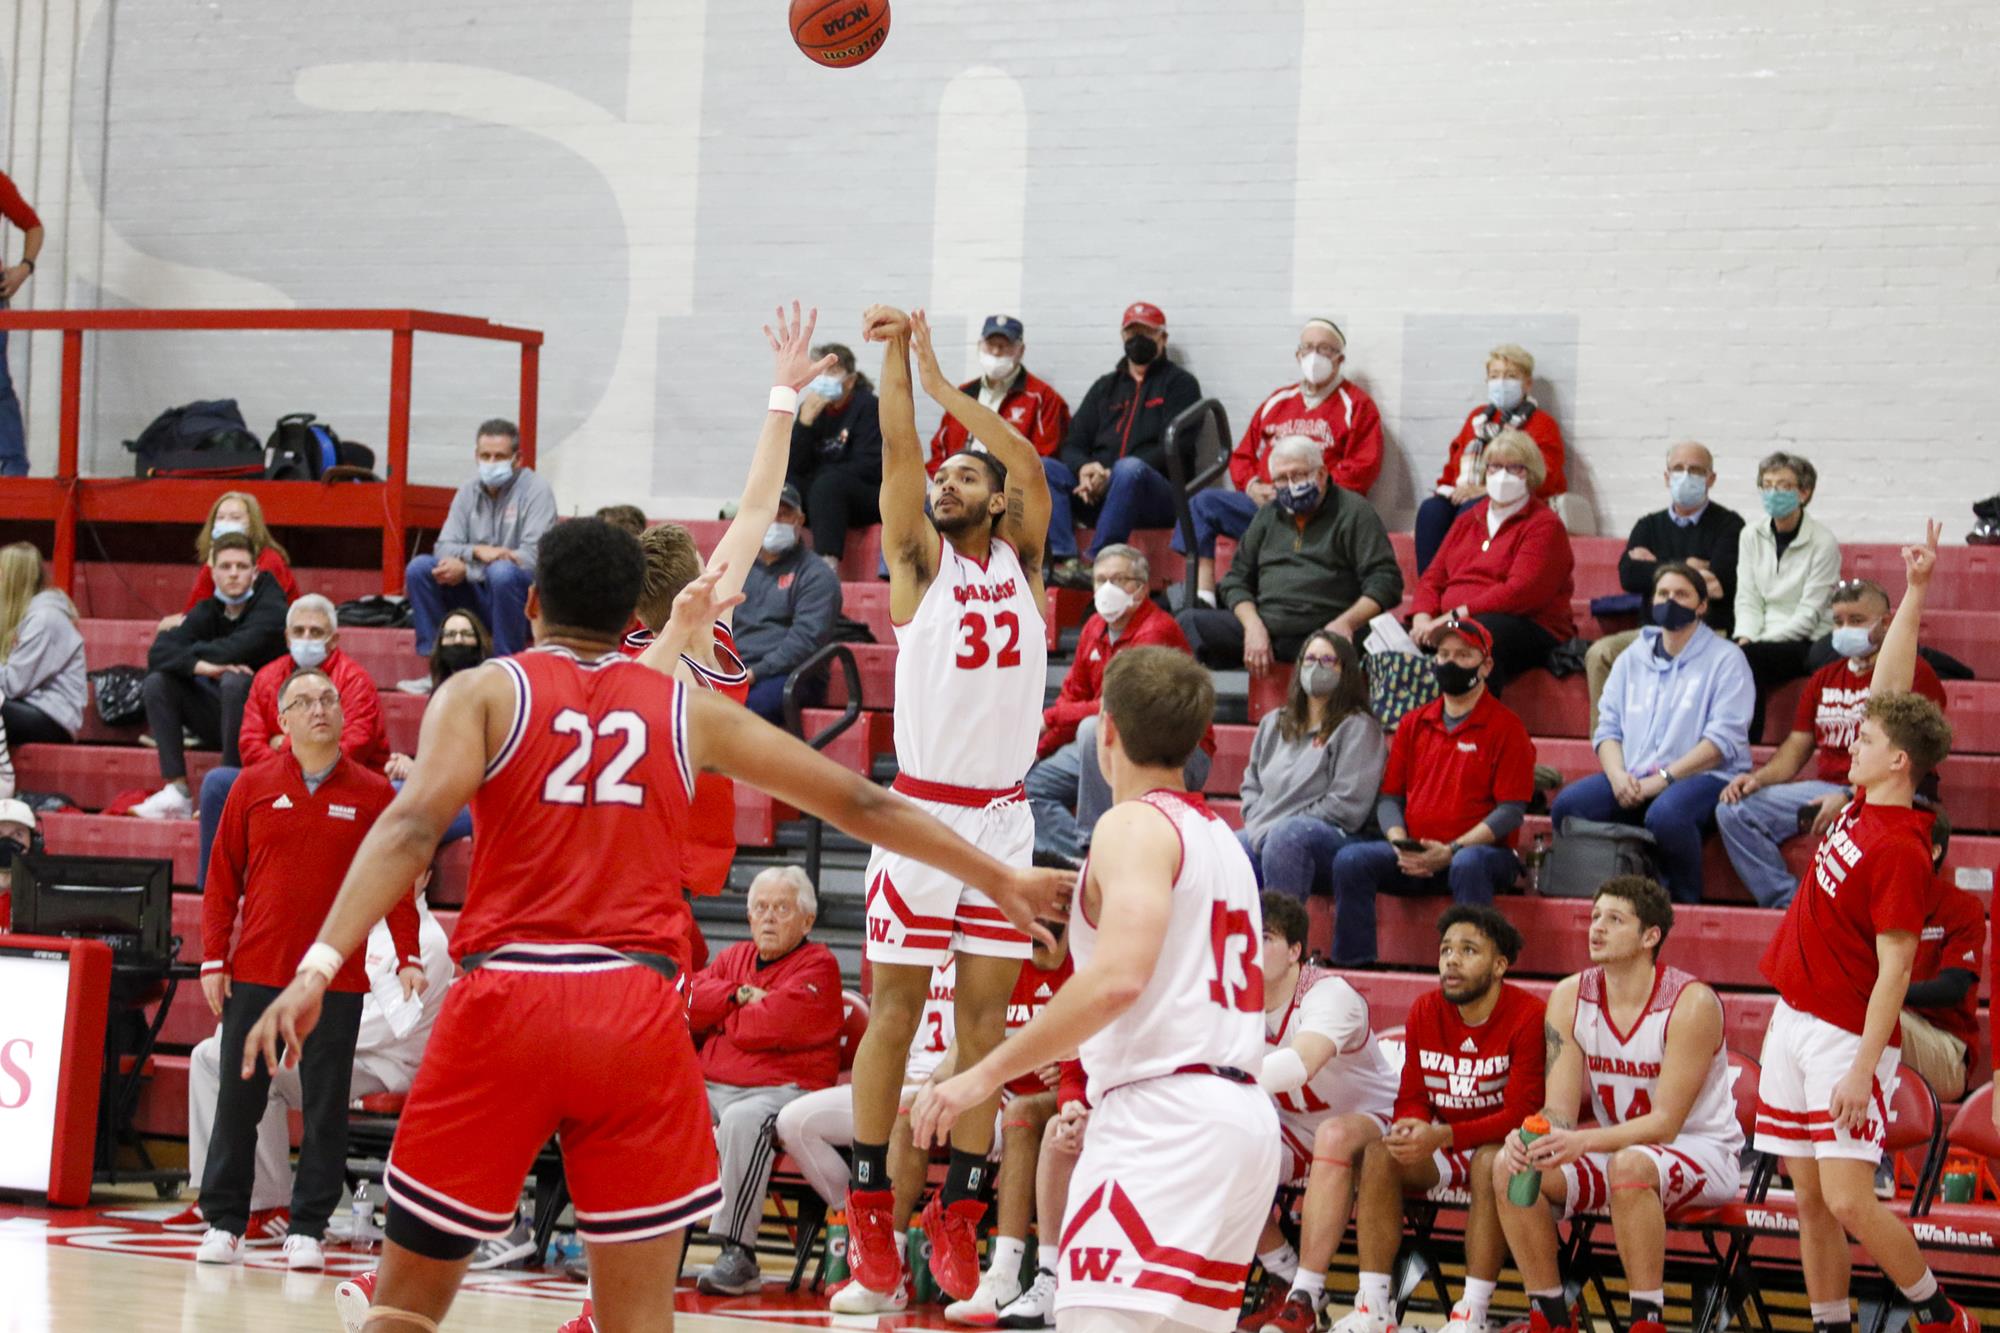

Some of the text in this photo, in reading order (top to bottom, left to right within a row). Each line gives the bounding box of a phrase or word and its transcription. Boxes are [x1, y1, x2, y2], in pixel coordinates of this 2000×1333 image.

[823, 4, 869, 37] NCAA
[956, 610, 1021, 670] 32
[540, 705, 649, 808] 22
[1209, 900, 1265, 1013] 13
[1419, 1049, 1510, 1078] WABASH
[1588, 1055, 1661, 1078] WABASH
[1448, 1073, 1478, 1097] W.
[1597, 1084, 1653, 1126] 14
[1745, 1209, 1800, 1232] Waba
[1912, 1222, 1994, 1248] Wabash
[1069, 1246, 1123, 1284] W.
